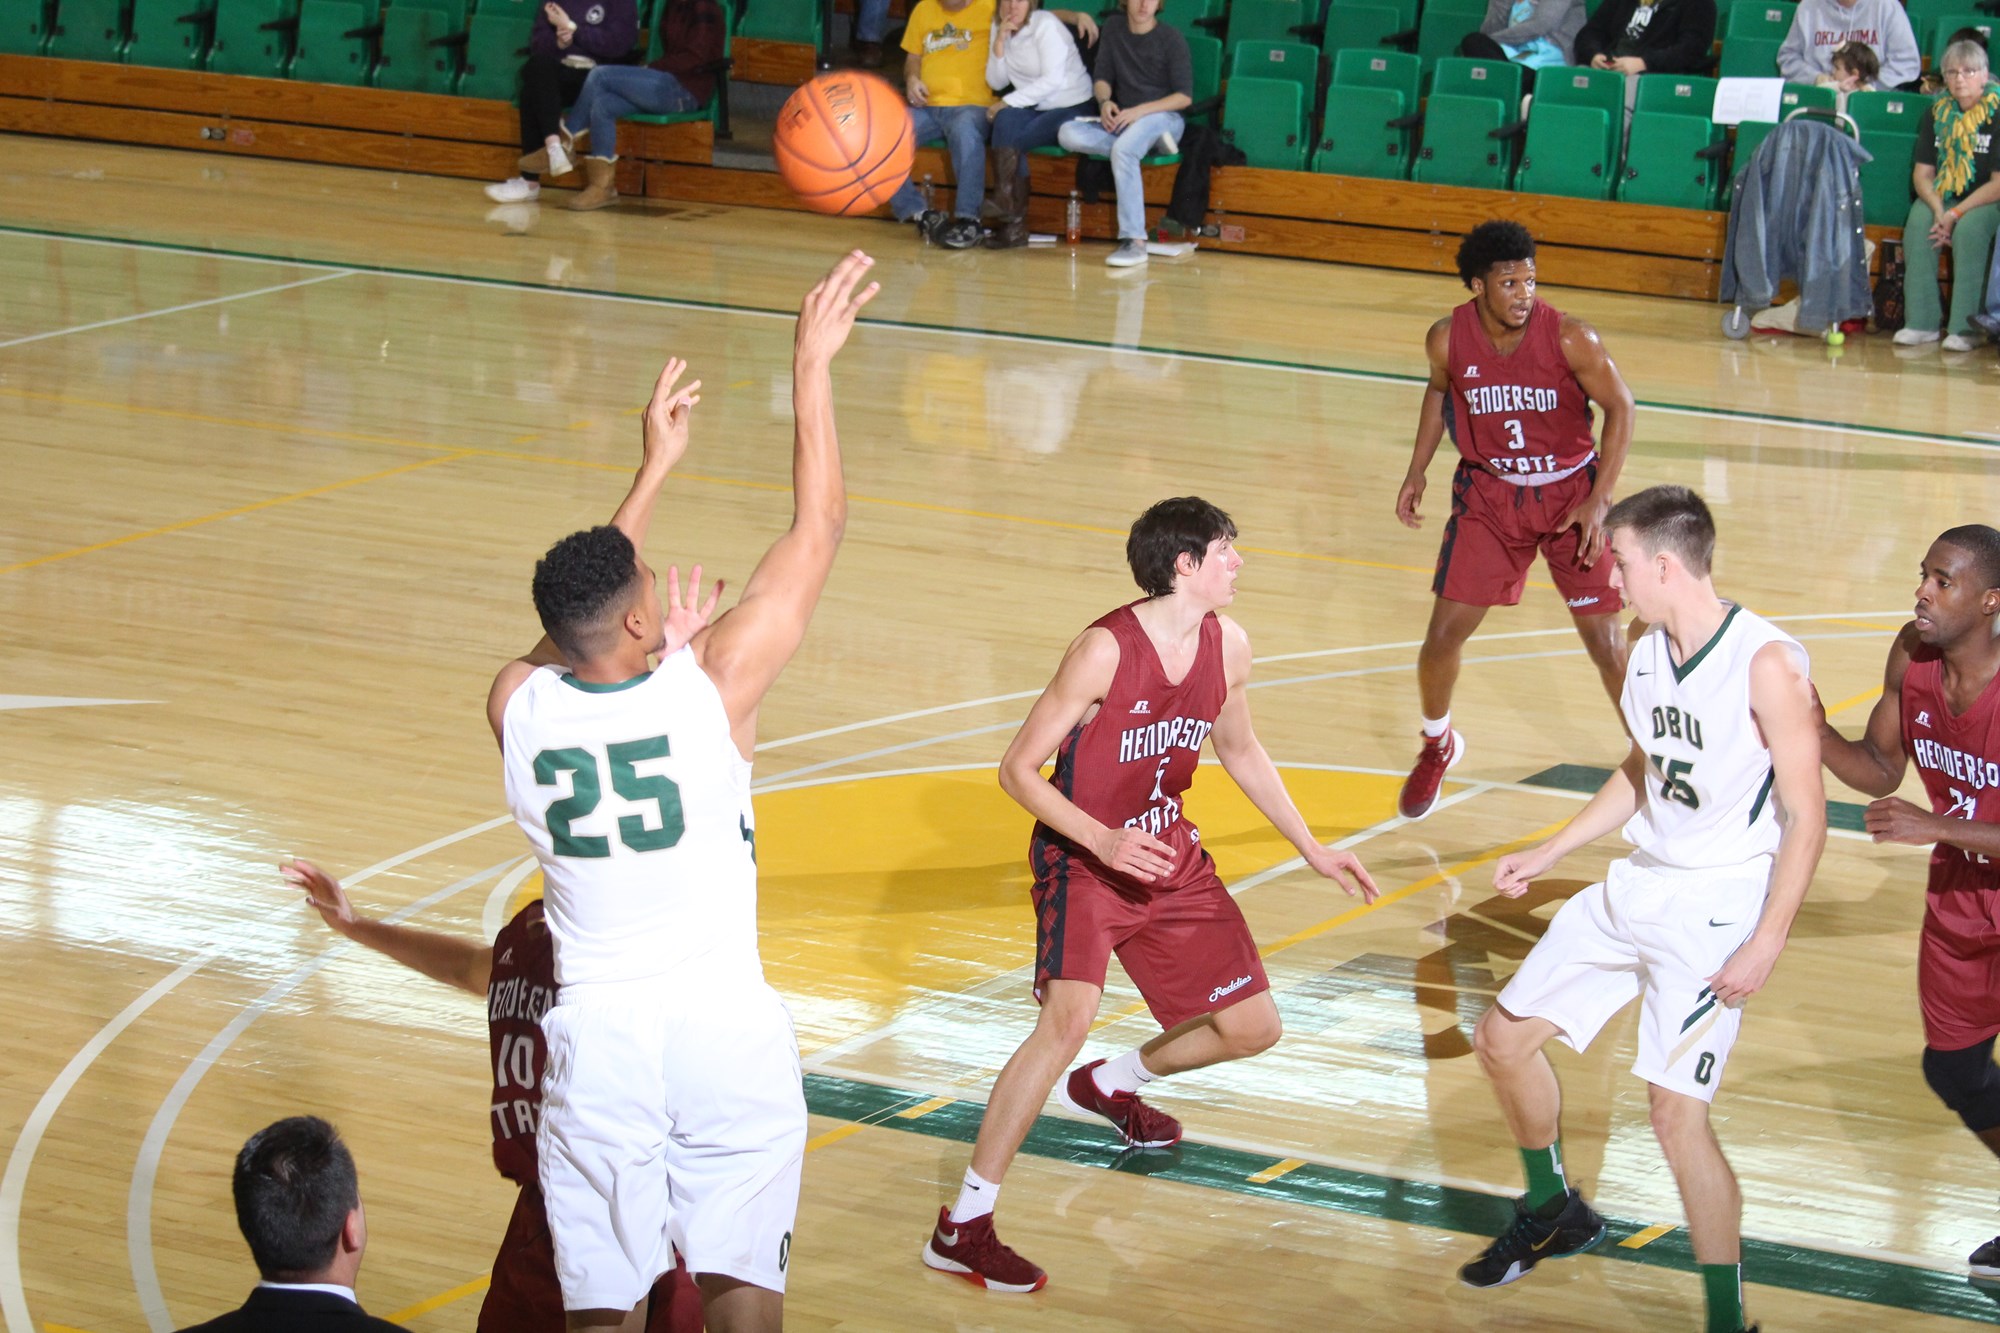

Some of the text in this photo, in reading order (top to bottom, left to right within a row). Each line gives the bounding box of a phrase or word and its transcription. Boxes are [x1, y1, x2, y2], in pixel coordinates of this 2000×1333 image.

[1464, 385, 1557, 415] HENDERSON
[1504, 419, 1526, 450] 3
[1118, 715, 1214, 764] HENDRSON
[1913, 738, 2000, 790] HENDERSO
[531, 732, 687, 860] 25
[497, 1033, 535, 1090] 10
